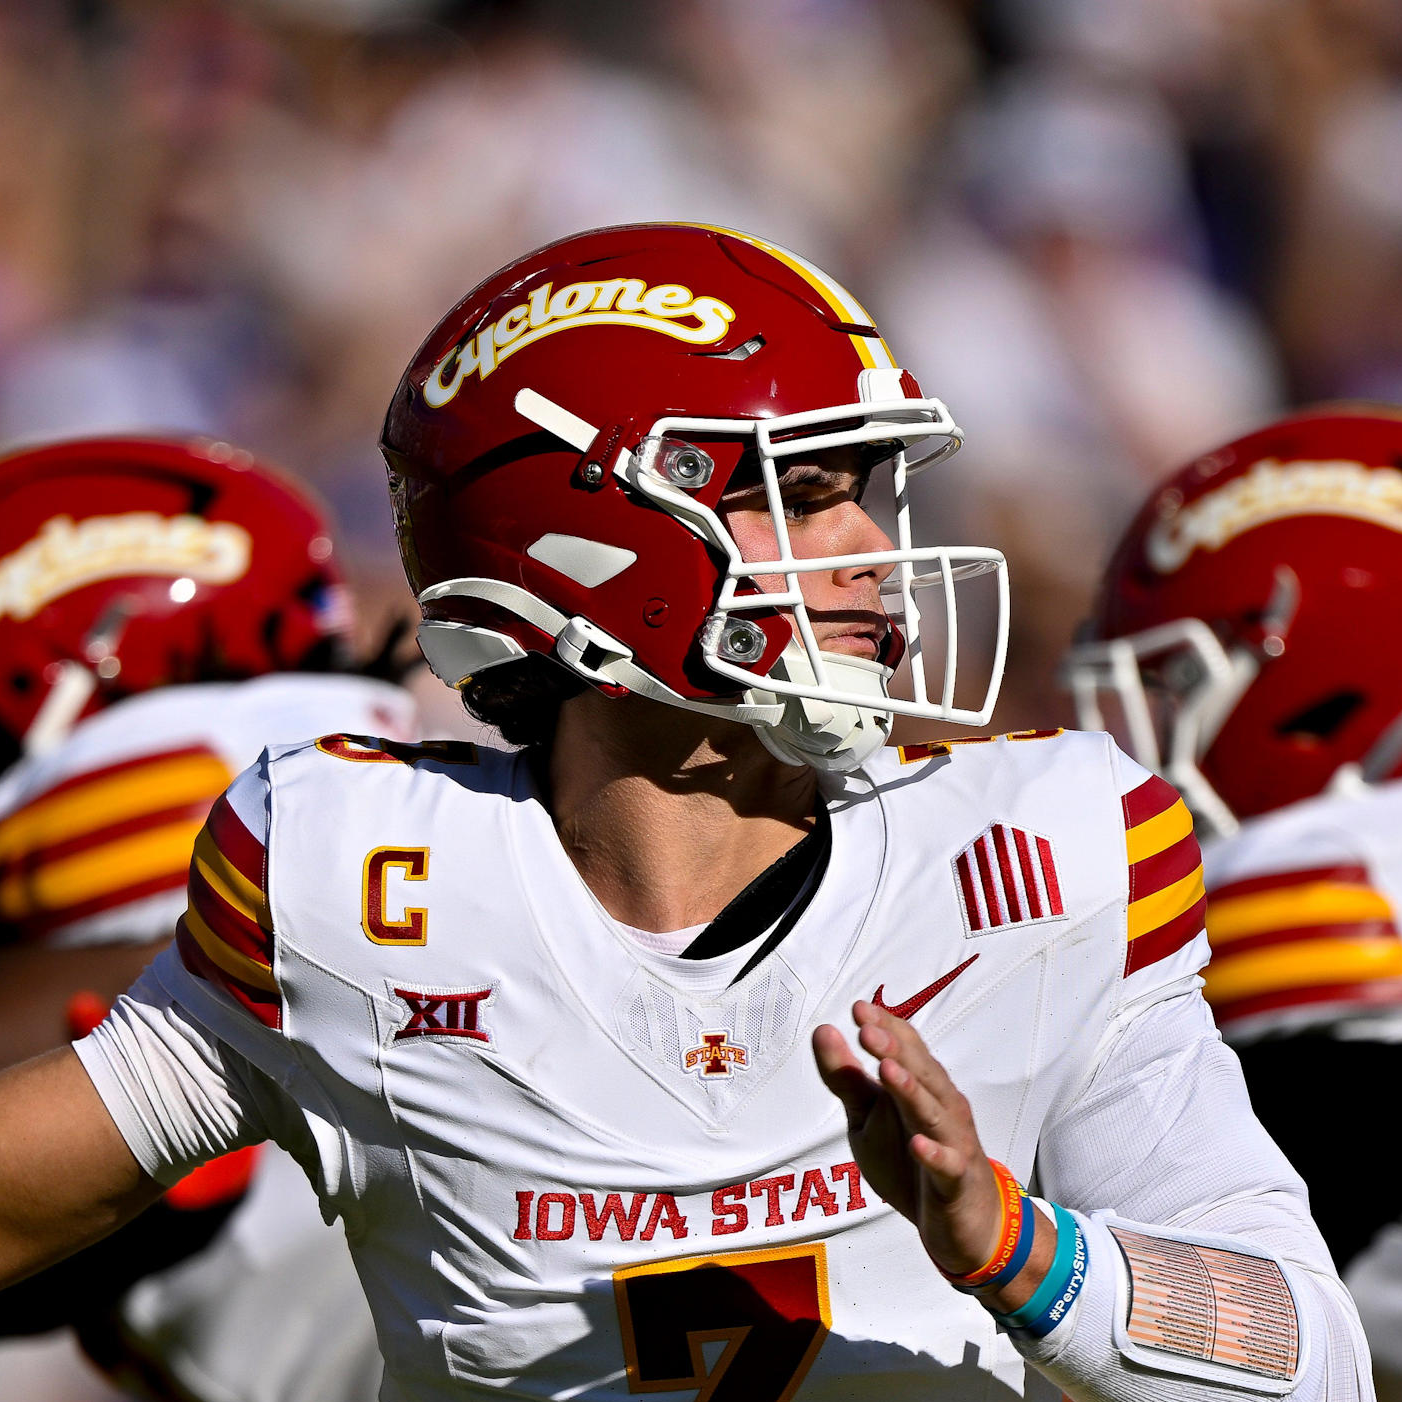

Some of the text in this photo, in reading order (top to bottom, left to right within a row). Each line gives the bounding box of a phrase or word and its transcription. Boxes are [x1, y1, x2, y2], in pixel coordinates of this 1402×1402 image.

[423, 277, 737, 408] Cyclones
[361, 845, 431, 947] C
[685, 1045, 747, 1069] STATE
[513, 1161, 873, 1242] IOWA STAT
[989, 1218, 1019, 1275] Cyclone
